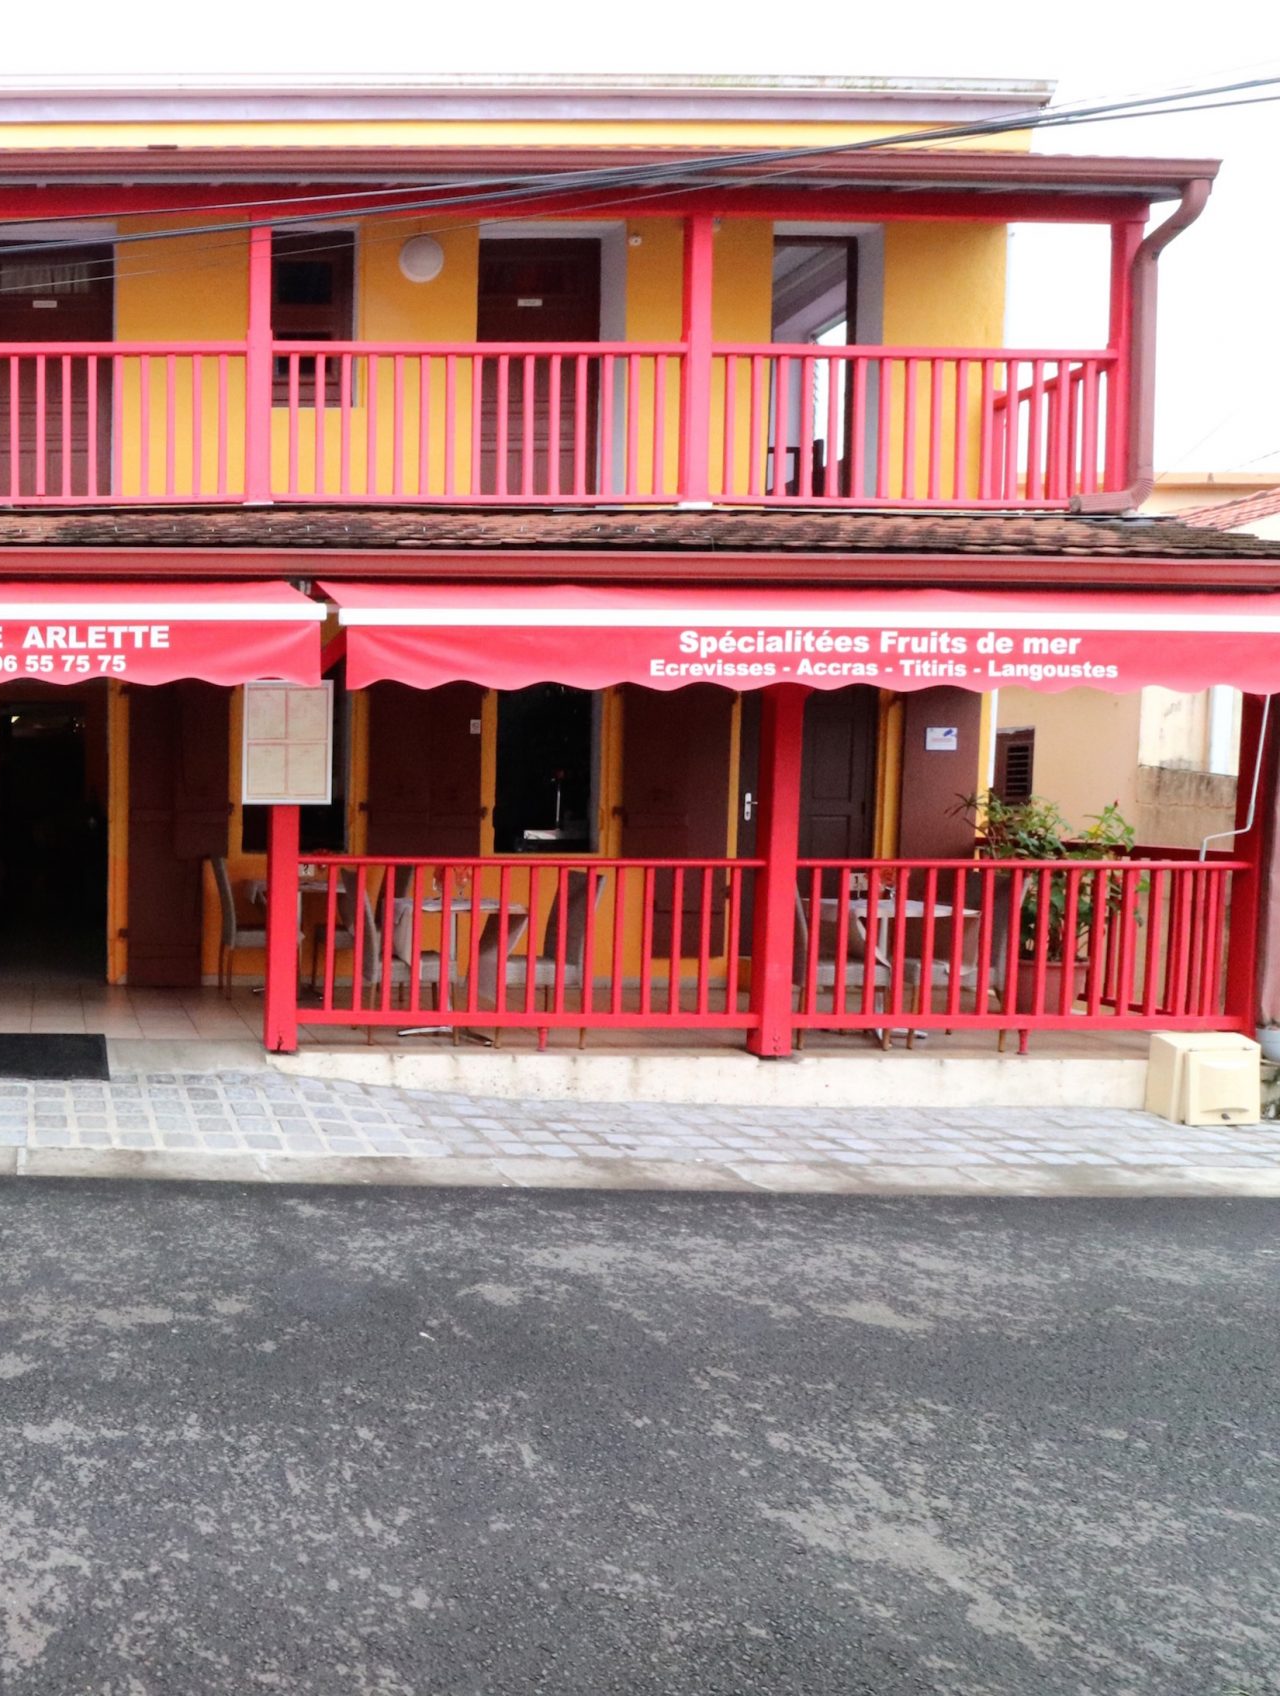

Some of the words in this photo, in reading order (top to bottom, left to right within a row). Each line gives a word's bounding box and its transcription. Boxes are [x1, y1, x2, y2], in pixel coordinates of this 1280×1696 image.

[22, 625, 170, 649] ARLETTE
[679, 630, 870, 658] Spécialitées
[880, 631, 967, 654] Fruits
[976, 632, 1014, 654] de
[1023, 636, 1081, 655] mer
[25, 655, 54, 673] 55
[61, 655, 91, 673] 75
[98, 655, 127, 673] 75
[650, 658, 776, 677] Ecrevisses
[796, 658, 880, 677] Accras
[899, 659, 967, 677] Titiris
[988, 659, 1119, 681] Langoustes
